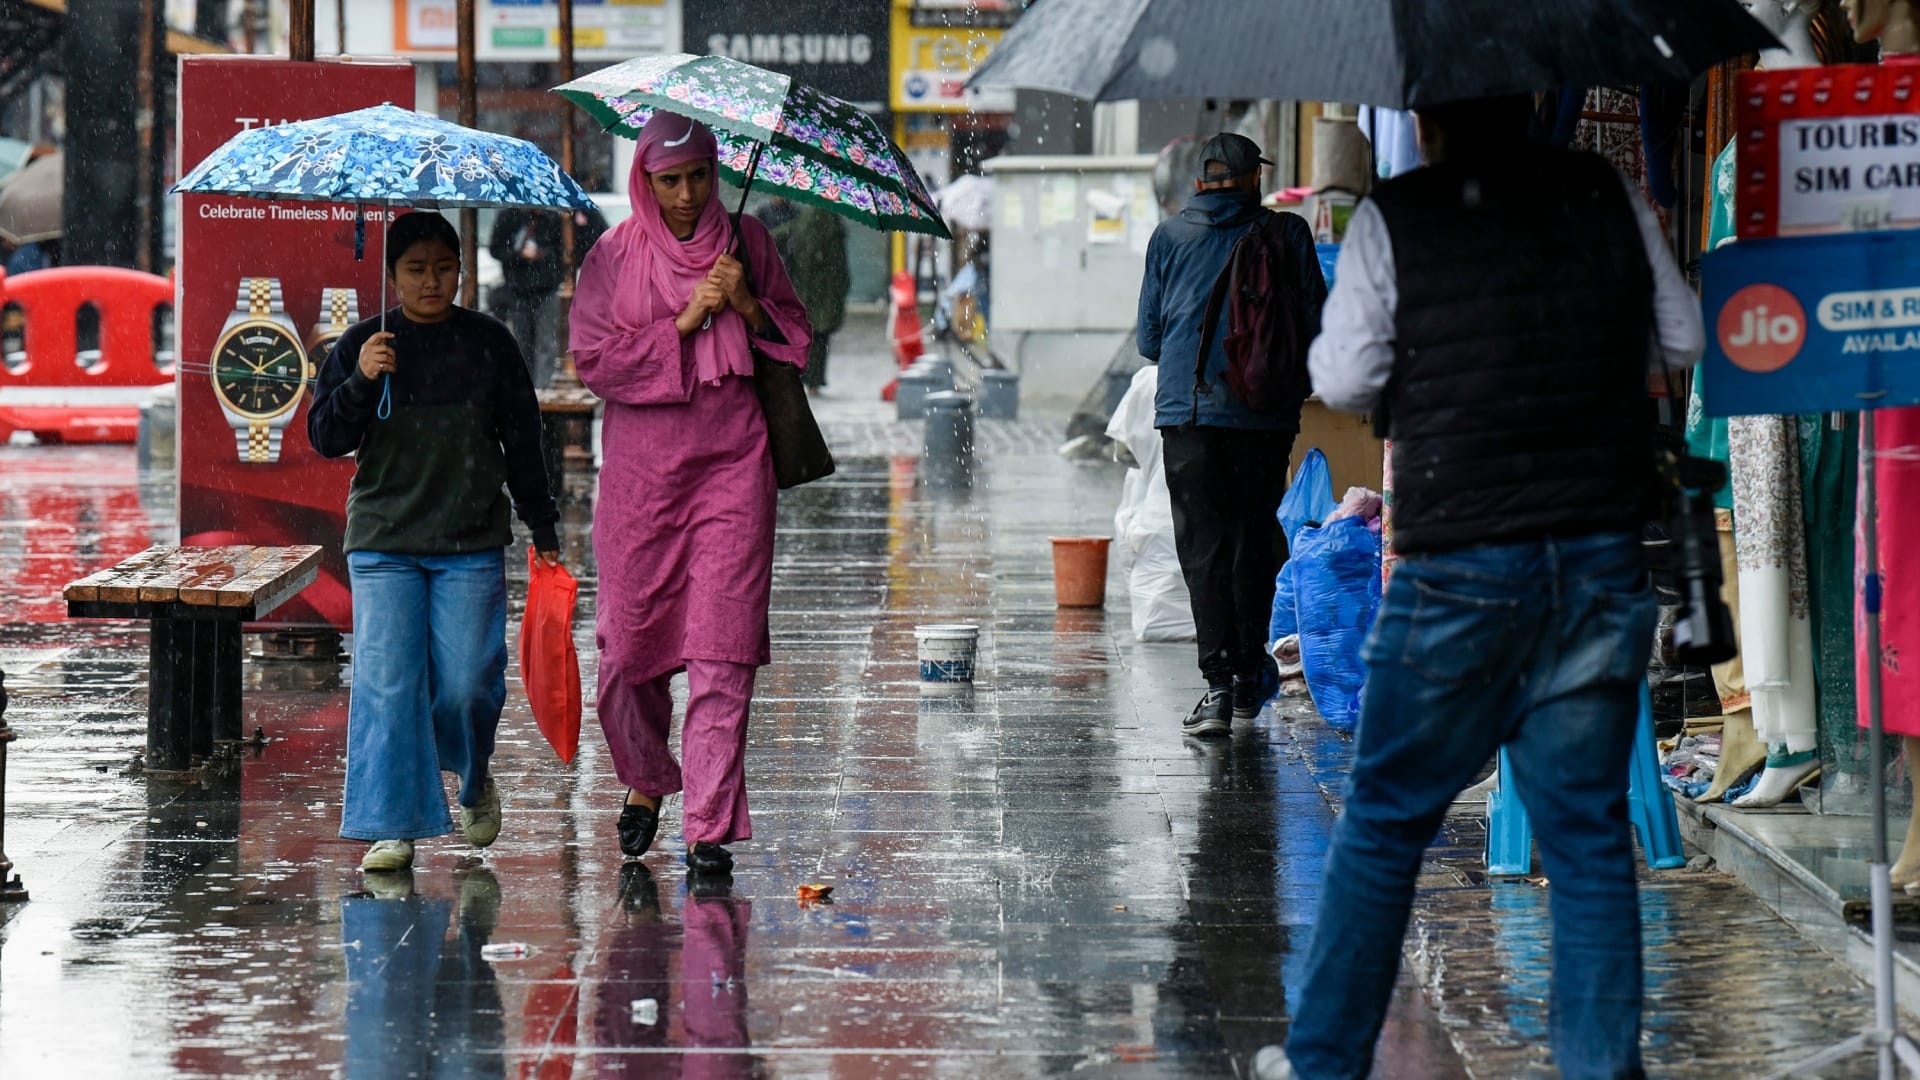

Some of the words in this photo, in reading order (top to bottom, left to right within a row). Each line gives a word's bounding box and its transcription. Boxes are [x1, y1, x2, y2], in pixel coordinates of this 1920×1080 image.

[708, 34, 871, 63] SAMSUNG
[1794, 165, 1850, 193] SIM
[1863, 163, 1920, 190] CAR
[200, 203, 266, 219] Celebrate
[268, 205, 329, 220] Timeless
[1831, 299, 1875, 322] SIM
[1881, 298, 1895, 319] &
[1903, 296, 1920, 316] R
[1729, 305, 1798, 347] Jio
[1841, 330, 1920, 355] AVAILA
